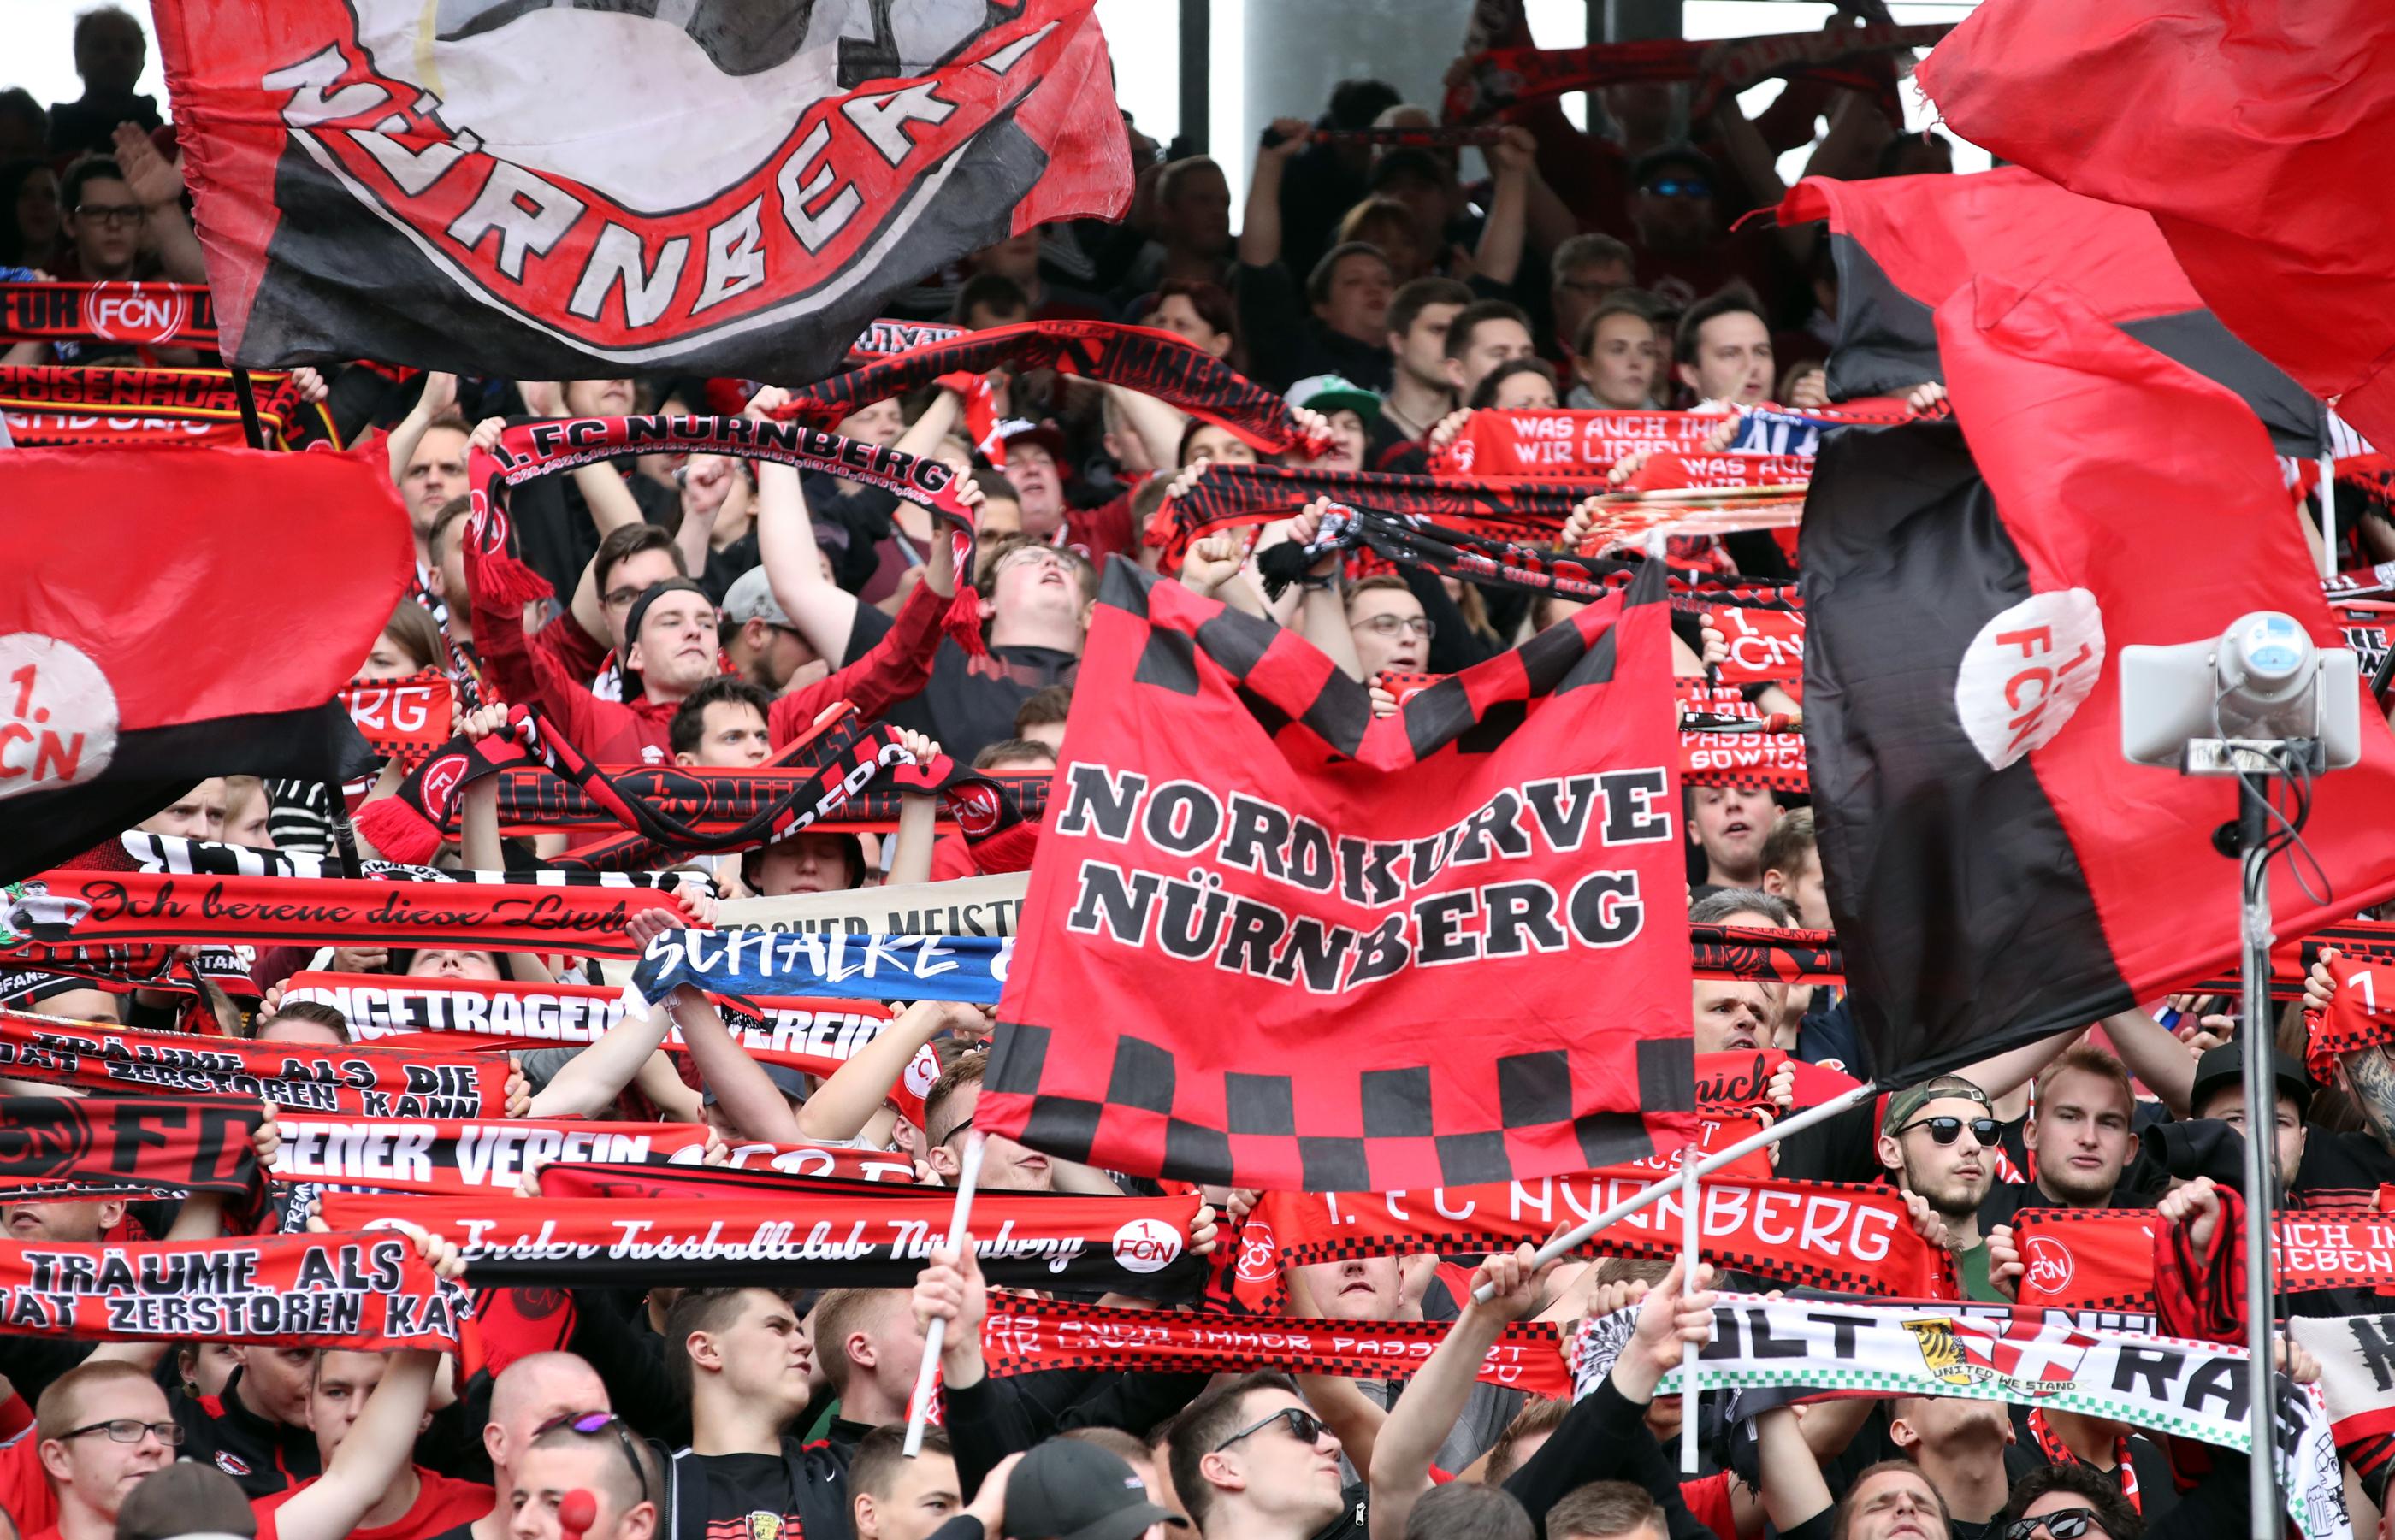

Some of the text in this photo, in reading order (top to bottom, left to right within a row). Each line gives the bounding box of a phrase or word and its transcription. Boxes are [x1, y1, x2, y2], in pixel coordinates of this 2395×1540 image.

[99, 299, 171, 329] FCN
[529, 419, 608, 460] FC
[1511, 416, 1575, 439] WAS
[1584, 416, 1667, 439] AUCH
[1679, 417, 1718, 439] IM
[1514, 440, 1574, 464] WIR
[1680, 457, 1817, 476] WAS AUC
[1724, 634, 1805, 671] CN
[11, 664, 50, 723] 1.
[339, 687, 432, 733] RG
[1996, 625, 2055, 754] FCN
[0, 723, 85, 782] CN
[1682, 731, 1806, 748] PASSIE
[1056, 761, 1673, 911] NORDKURVE
[81, 879, 191, 923] Ich
[492, 894, 632, 937] Lieb
[1066, 859, 1646, 996] NÜRNBERG
[645, 929, 960, 983] SCHALKE
[32, 1030, 479, 1099] TRÄUME ALS DIE
[1694, 1054, 1771, 1103] nich
[363, 1090, 481, 1119] KANN
[0, 1118, 72, 1164] CN
[455, 1219, 600, 1262] Erster
[887, 1219, 1087, 1274] Nünberg
[1115, 1237, 1181, 1266] FCN
[1136, 1222, 1156, 1239] 1.
[2271, 1224, 2354, 1248] UCH
[22, 1241, 404, 1297] TRÄUME ALS
[1237, 1234, 1275, 1277] FCN
[2030, 1258, 2067, 1281] FCN
[2271, 1248, 2394, 1273] IEBEN
[108, 1285, 360, 1335] ZERSTÖREN
[986, 1313, 1041, 1331] AS
[1190, 1328, 1313, 1352] IMMER
[1933, 1365, 2077, 1392] UNITED WE STAND
